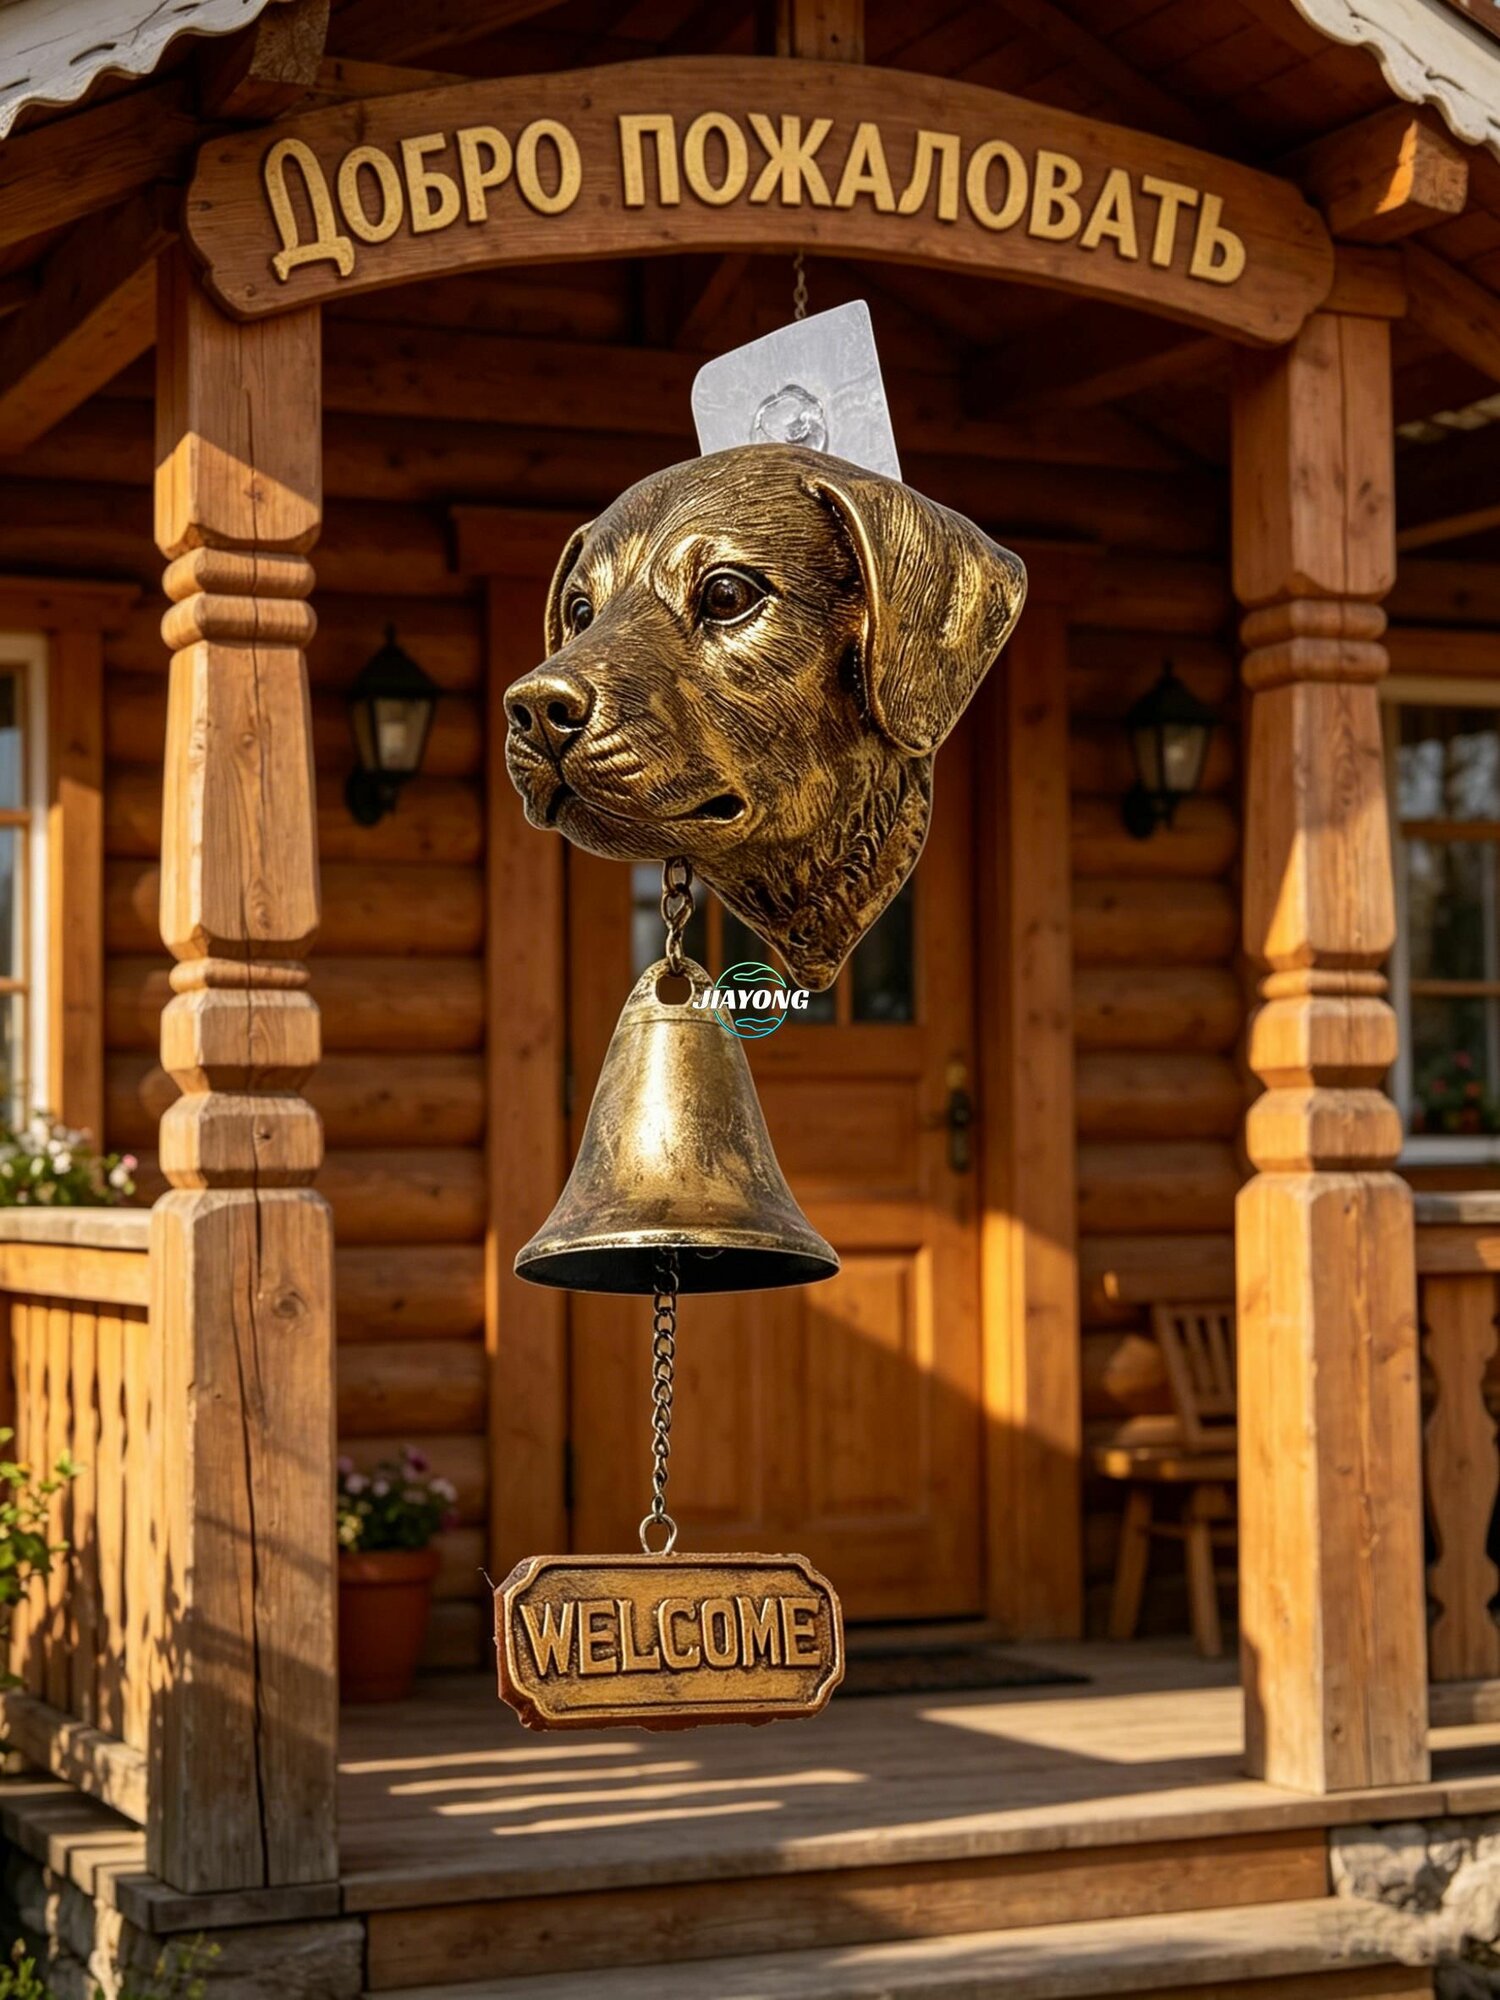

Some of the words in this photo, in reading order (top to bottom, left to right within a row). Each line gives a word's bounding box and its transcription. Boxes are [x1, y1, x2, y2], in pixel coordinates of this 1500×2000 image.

[264, 119, 583, 282] ДОБРО
[618, 111, 1246, 284] ПОЖАЛОВАТЬ
[519, 1596, 821, 1677] WELCOME
